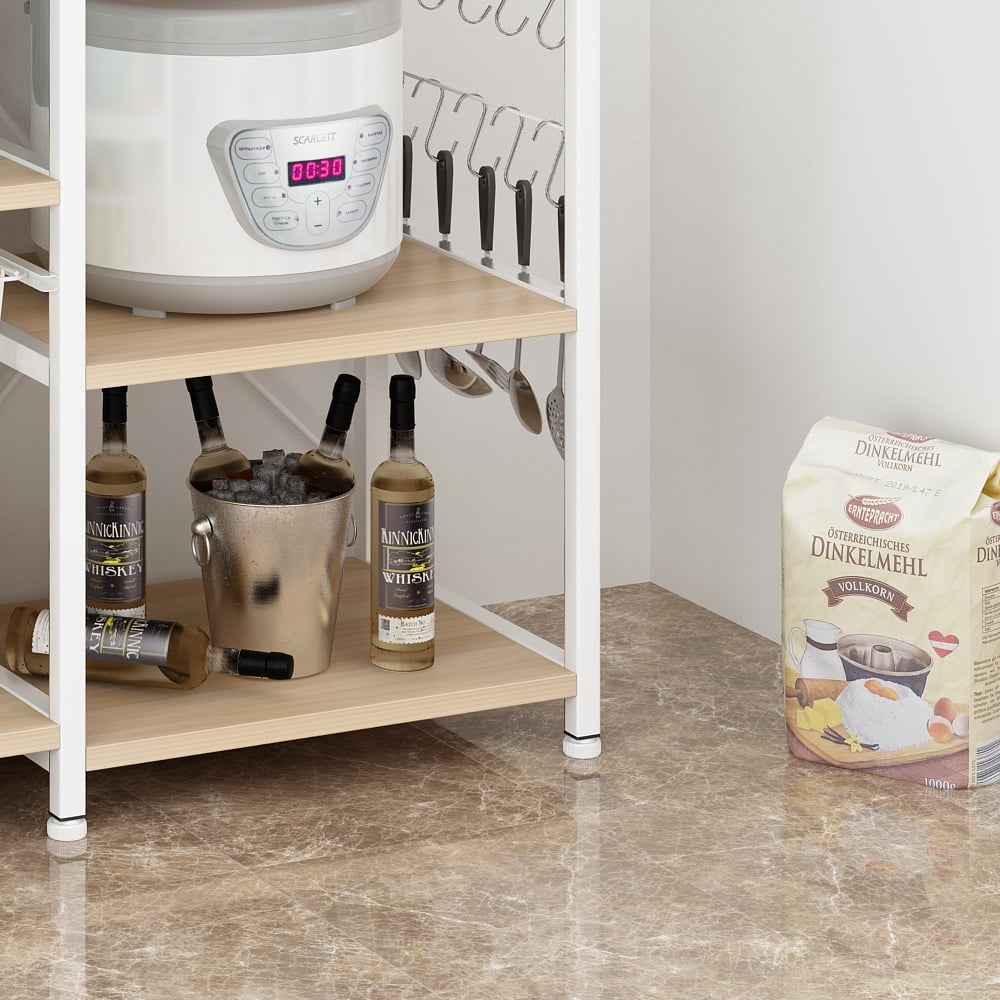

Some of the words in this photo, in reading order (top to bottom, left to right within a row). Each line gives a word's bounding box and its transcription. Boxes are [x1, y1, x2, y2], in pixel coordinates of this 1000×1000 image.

[293, 131, 337, 145] SCARLETT
[291, 158, 343, 181] 00:30
[855, 440, 942, 467] DINKELMEHL
[877, 459, 913, 472] VOLLKORN
[847, 504, 900, 526] ERNTEPRACHT
[827, 526, 910, 553] ÖSTERREICHISCHES
[811, 534, 928, 577] DINKELMEHL
[838, 581, 895, 602] VOLLKORN
